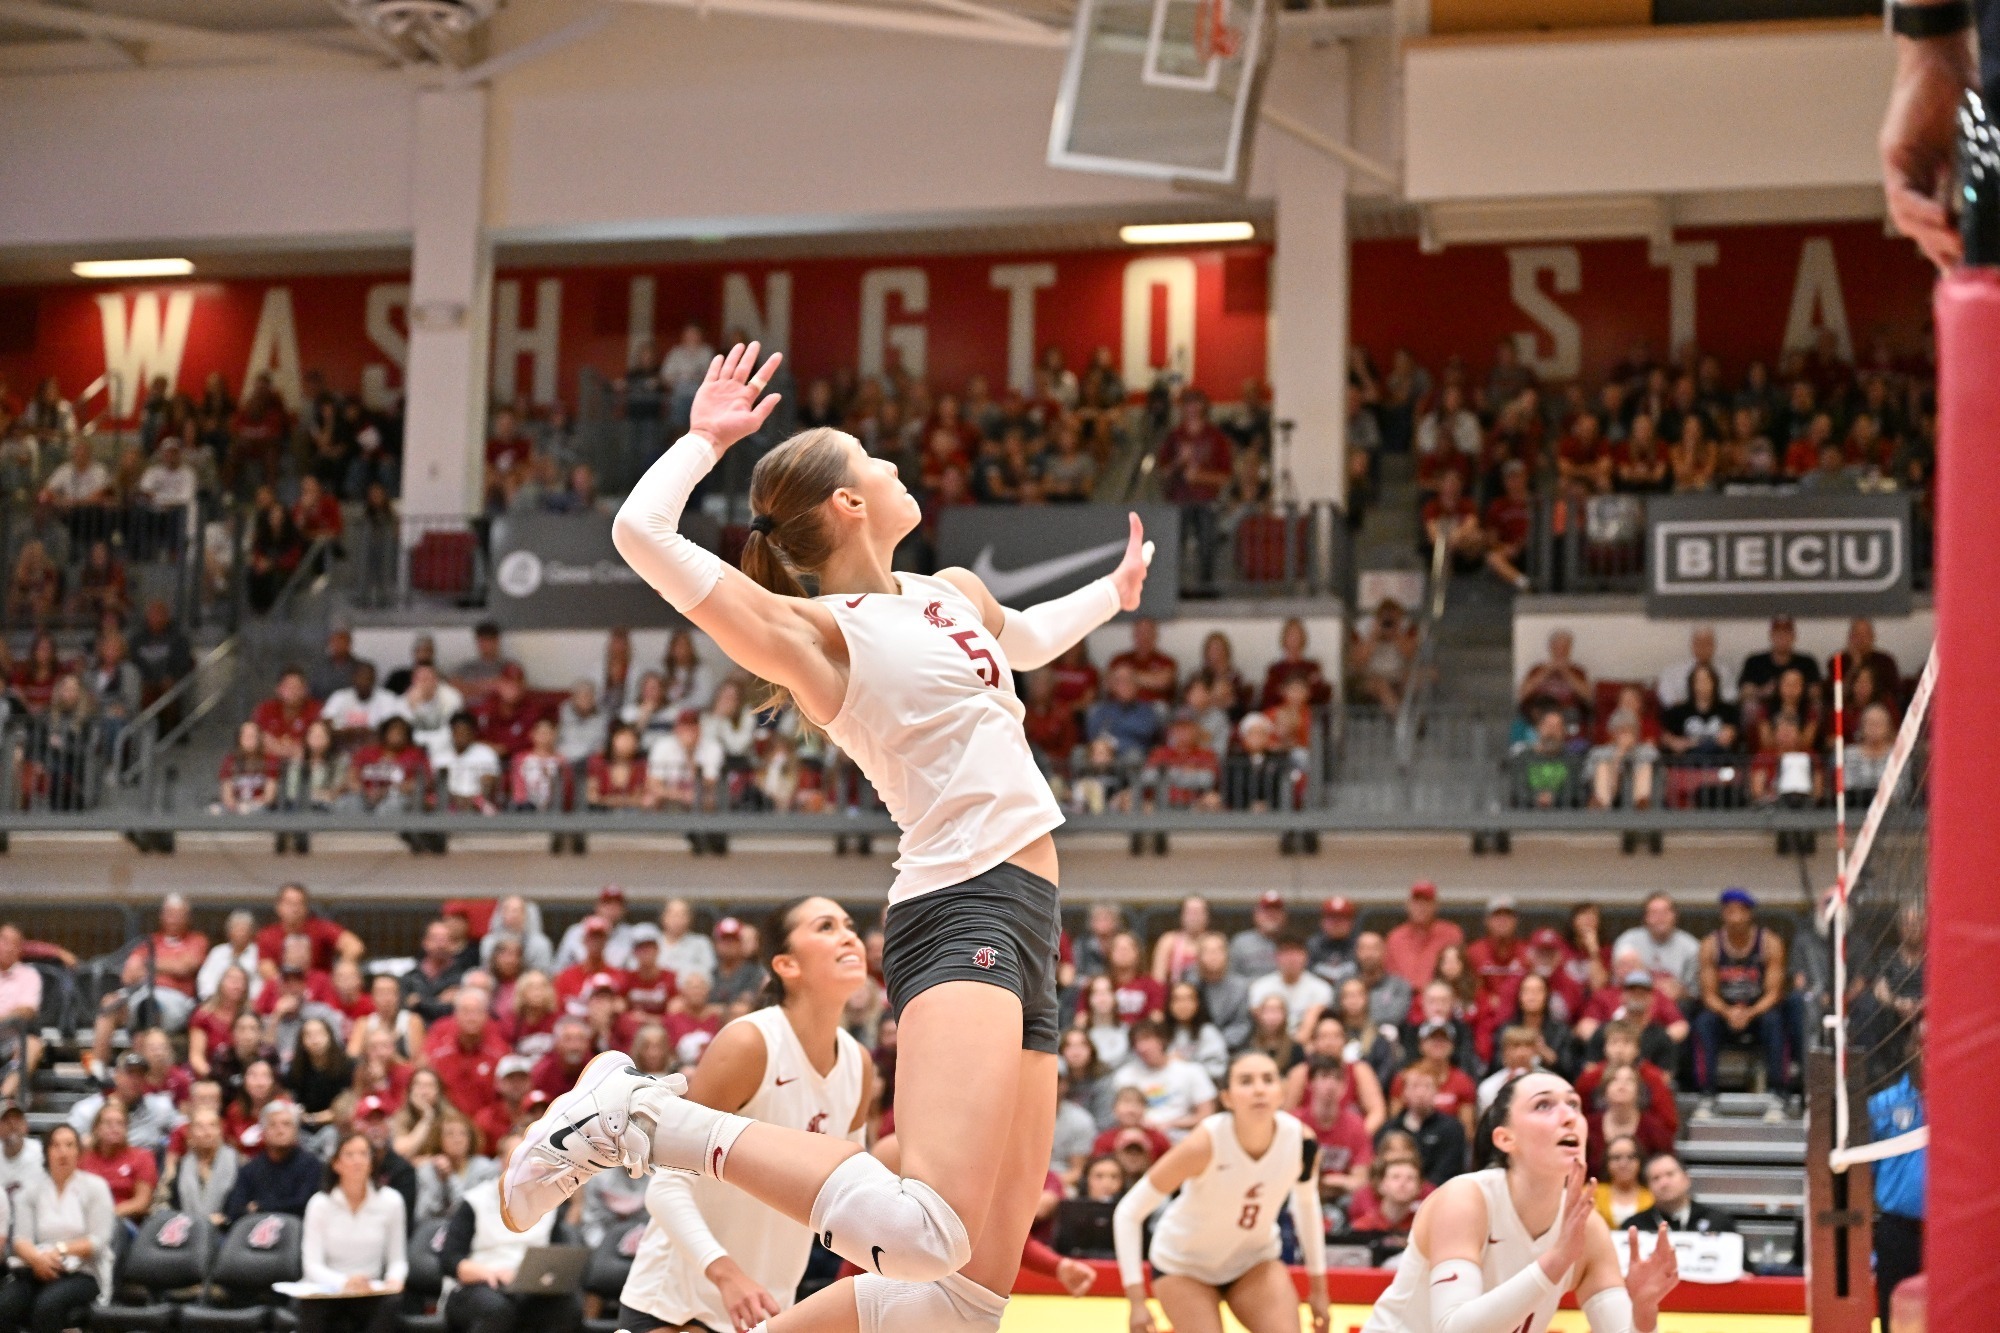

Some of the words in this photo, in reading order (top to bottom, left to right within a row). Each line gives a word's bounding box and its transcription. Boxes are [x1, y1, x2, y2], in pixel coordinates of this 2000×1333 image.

[1676, 534, 1882, 578] BECU
[948, 630, 1000, 688] 5
[1238, 1203, 1261, 1230] 8
